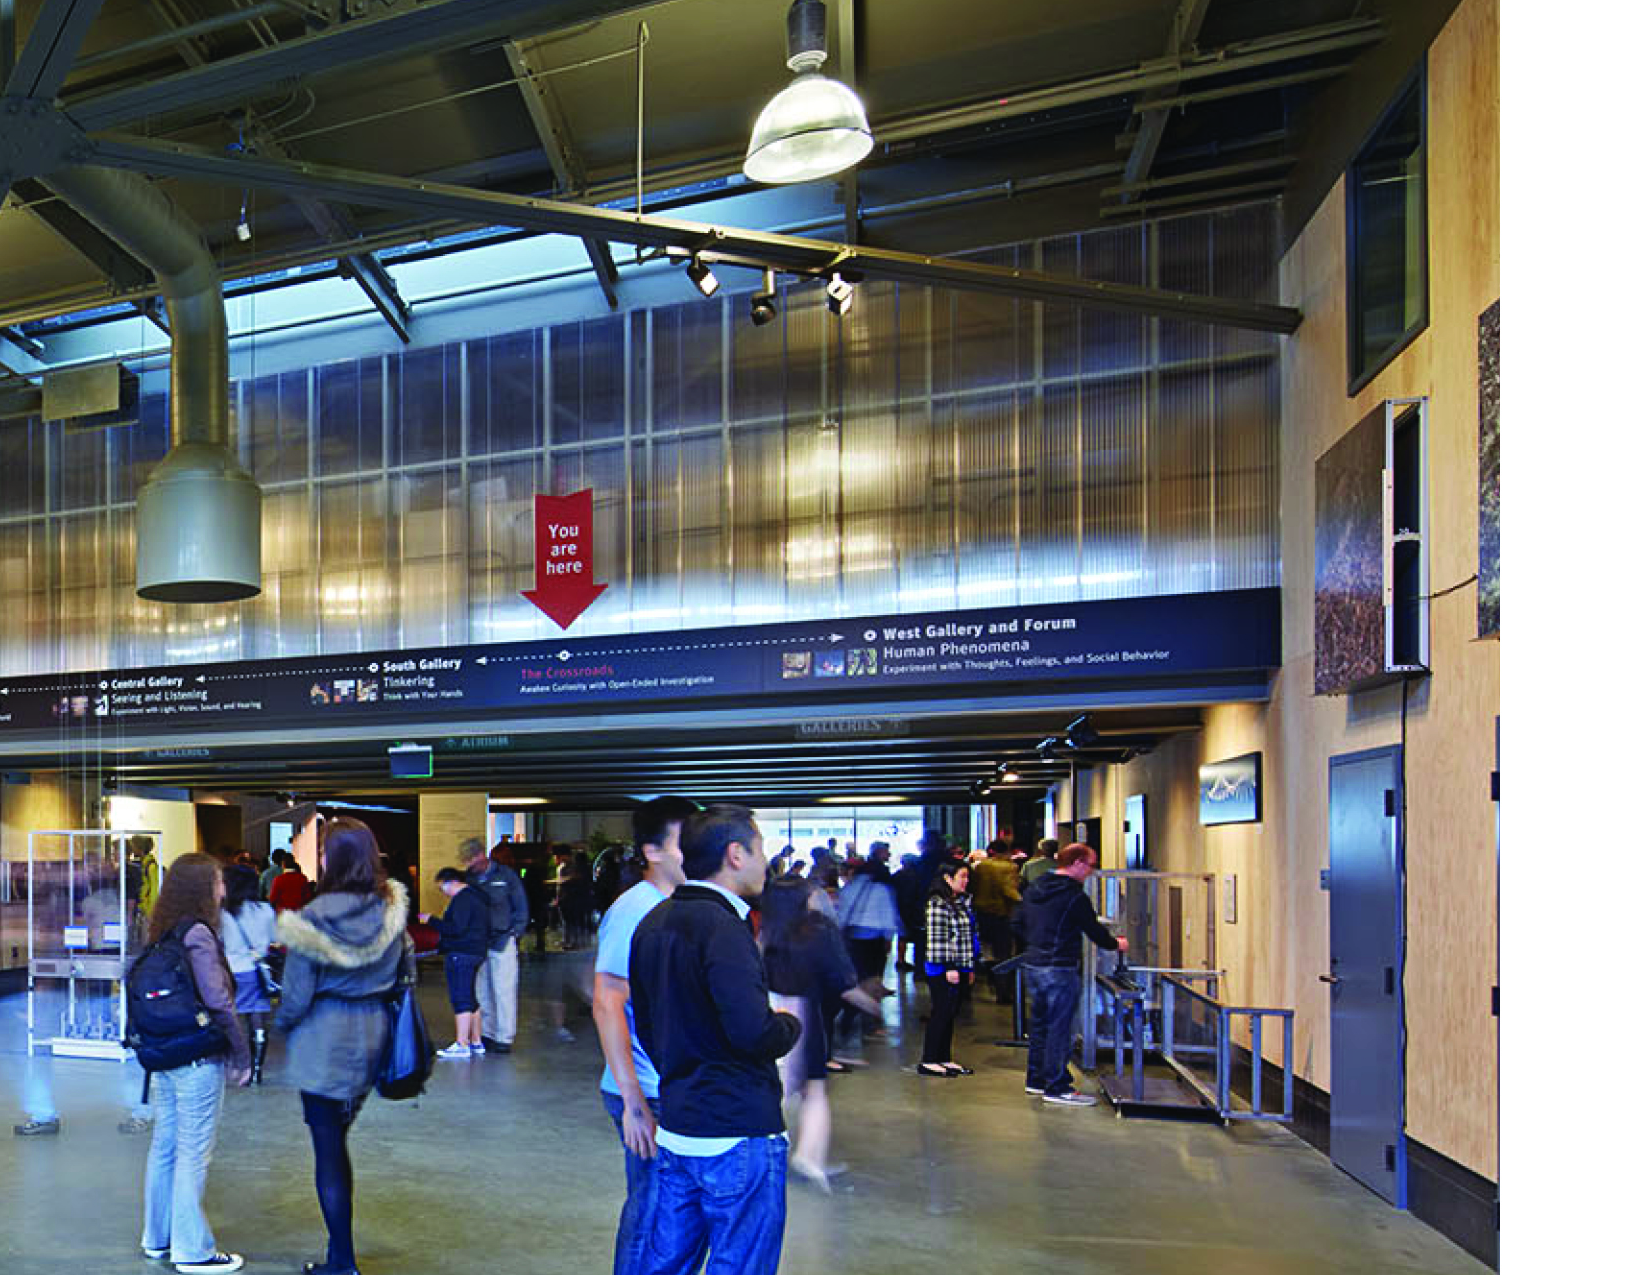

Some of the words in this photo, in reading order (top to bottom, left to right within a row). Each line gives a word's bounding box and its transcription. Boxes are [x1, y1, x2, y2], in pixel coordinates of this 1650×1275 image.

[548, 523, 579, 539] You
[550, 543, 578, 557] are
[546, 560, 583, 575] here
[883, 627, 921, 641] West
[926, 623, 984, 639] Gallery
[988, 620, 1018, 634] and
[1024, 618, 1077, 632] Forum
[883, 646, 936, 659] Human
[940, 640, 1030, 655] Phenomena
[383, 660, 416, 673] South
[419, 658, 462, 671] Gallery
[882, 663, 937, 676] Experiment
[939, 661, 962, 671] with
[964, 658, 1011, 670] Thoughts,
[1015, 655, 1061, 668] Feelings,
[1064, 653, 1083, 664] and
[1086, 651, 1119, 664] Social
[1122, 649, 1170, 661] Behavior
[521, 667, 542, 679] The
[546, 664, 614, 679] Crossroads
[111, 677, 145, 689] Central
[147, 675, 183, 687] Gallery
[383, 675, 435, 688] Tinkering
[111, 691, 142, 705] Seeing
[144, 690, 162, 701] and
[164, 689, 208, 702] Listening
[801, 718, 881, 733] GALLERIES
